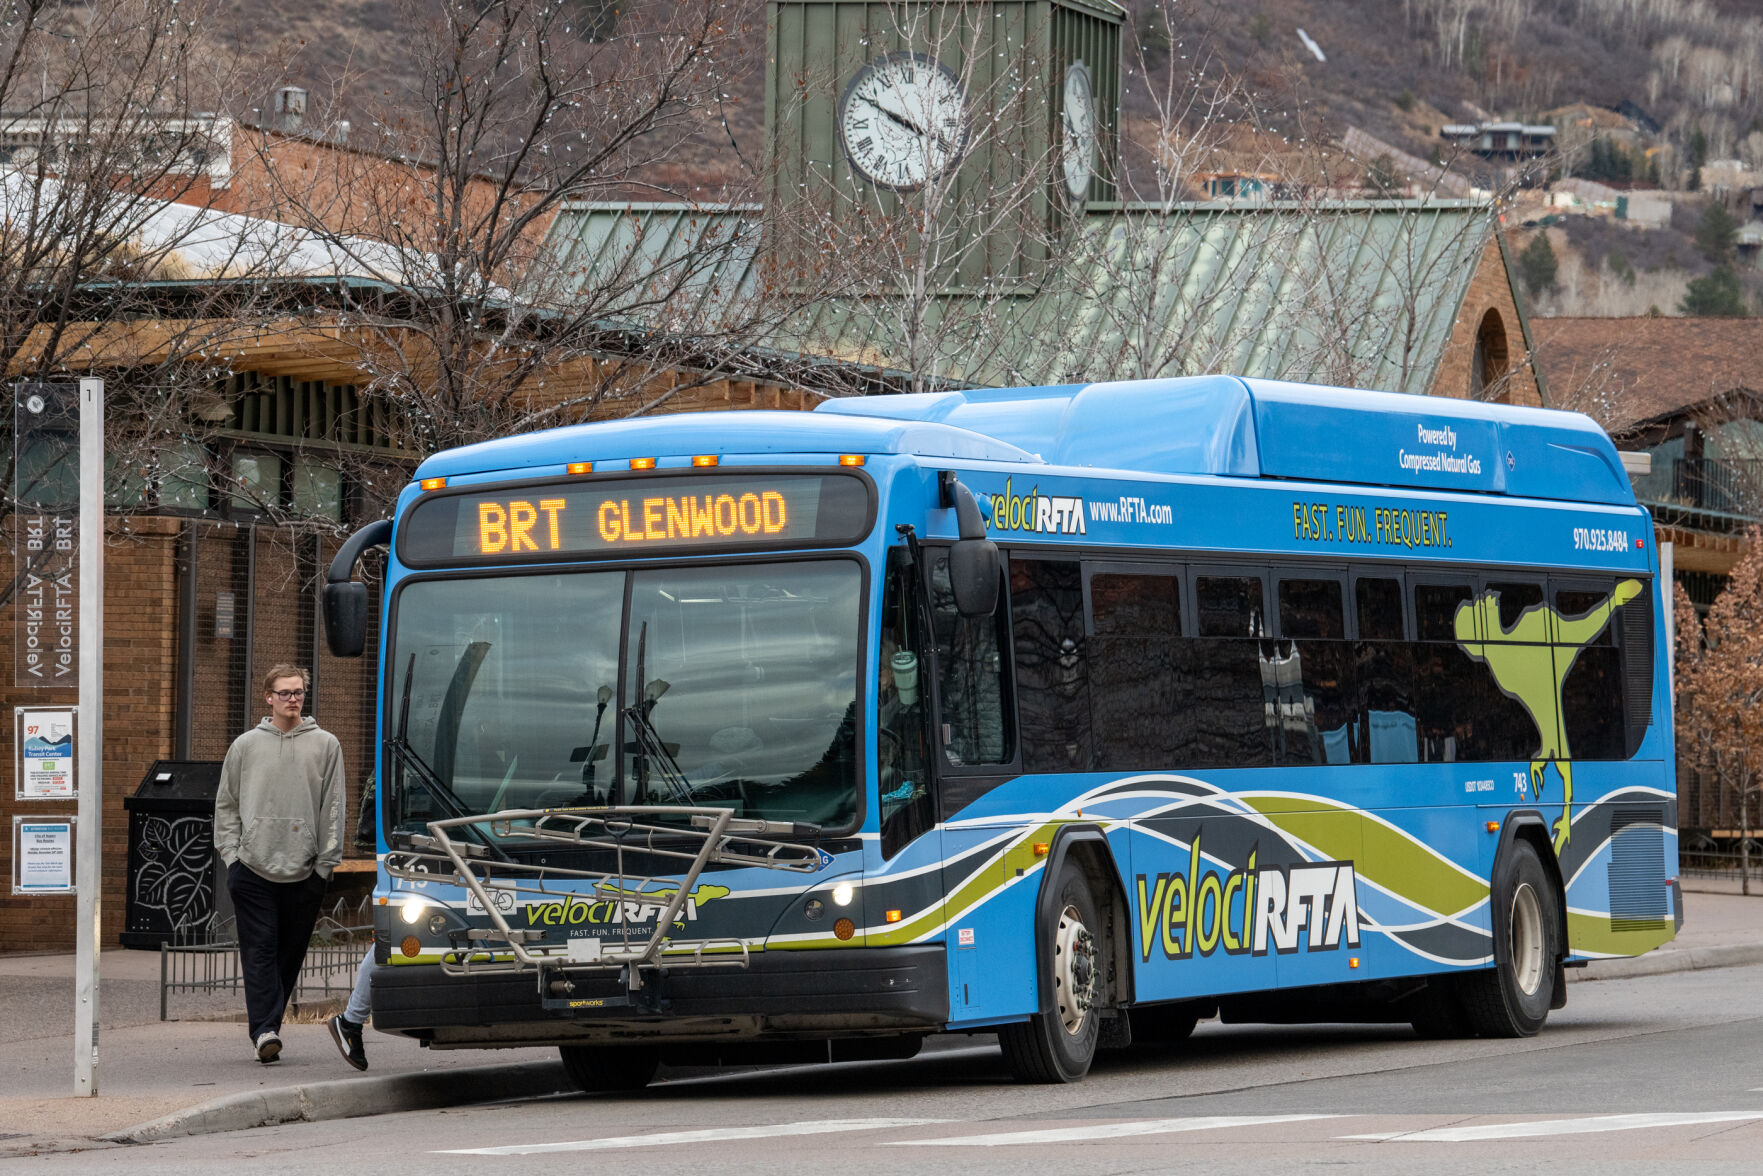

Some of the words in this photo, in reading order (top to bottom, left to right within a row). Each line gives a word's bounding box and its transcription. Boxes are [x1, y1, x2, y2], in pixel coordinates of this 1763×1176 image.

[86, 389, 91, 402] 1
[1417, 424, 1448, 445] Powered
[1448, 425, 1457, 451] by
[1399, 449, 1441, 475] Compressed
[1441, 452, 1467, 473] Natural
[1467, 455, 1482, 475] Gas
[478, 499, 566, 553] BRT
[598, 491, 787, 542] GLENWOOD
[1089, 496, 1173, 525] www.RFTA.com
[55, 518, 72, 550] BRT
[1292, 502, 1333, 541] FAST.
[1336, 505, 1372, 543] FUN.
[1374, 507, 1453, 550] FREQUENT.
[1573, 528, 1629, 553] 970.925.8484
[55, 573, 72, 677] VelociRFTA
[27, 725, 39, 734] 97
[1513, 772, 1527, 793] 743
[1135, 823, 1361, 963] velociRFTA
[570, 929, 590, 937] FAST.
[592, 928, 610, 937] FUN.
[612, 927, 654, 936] FREQUENT.
